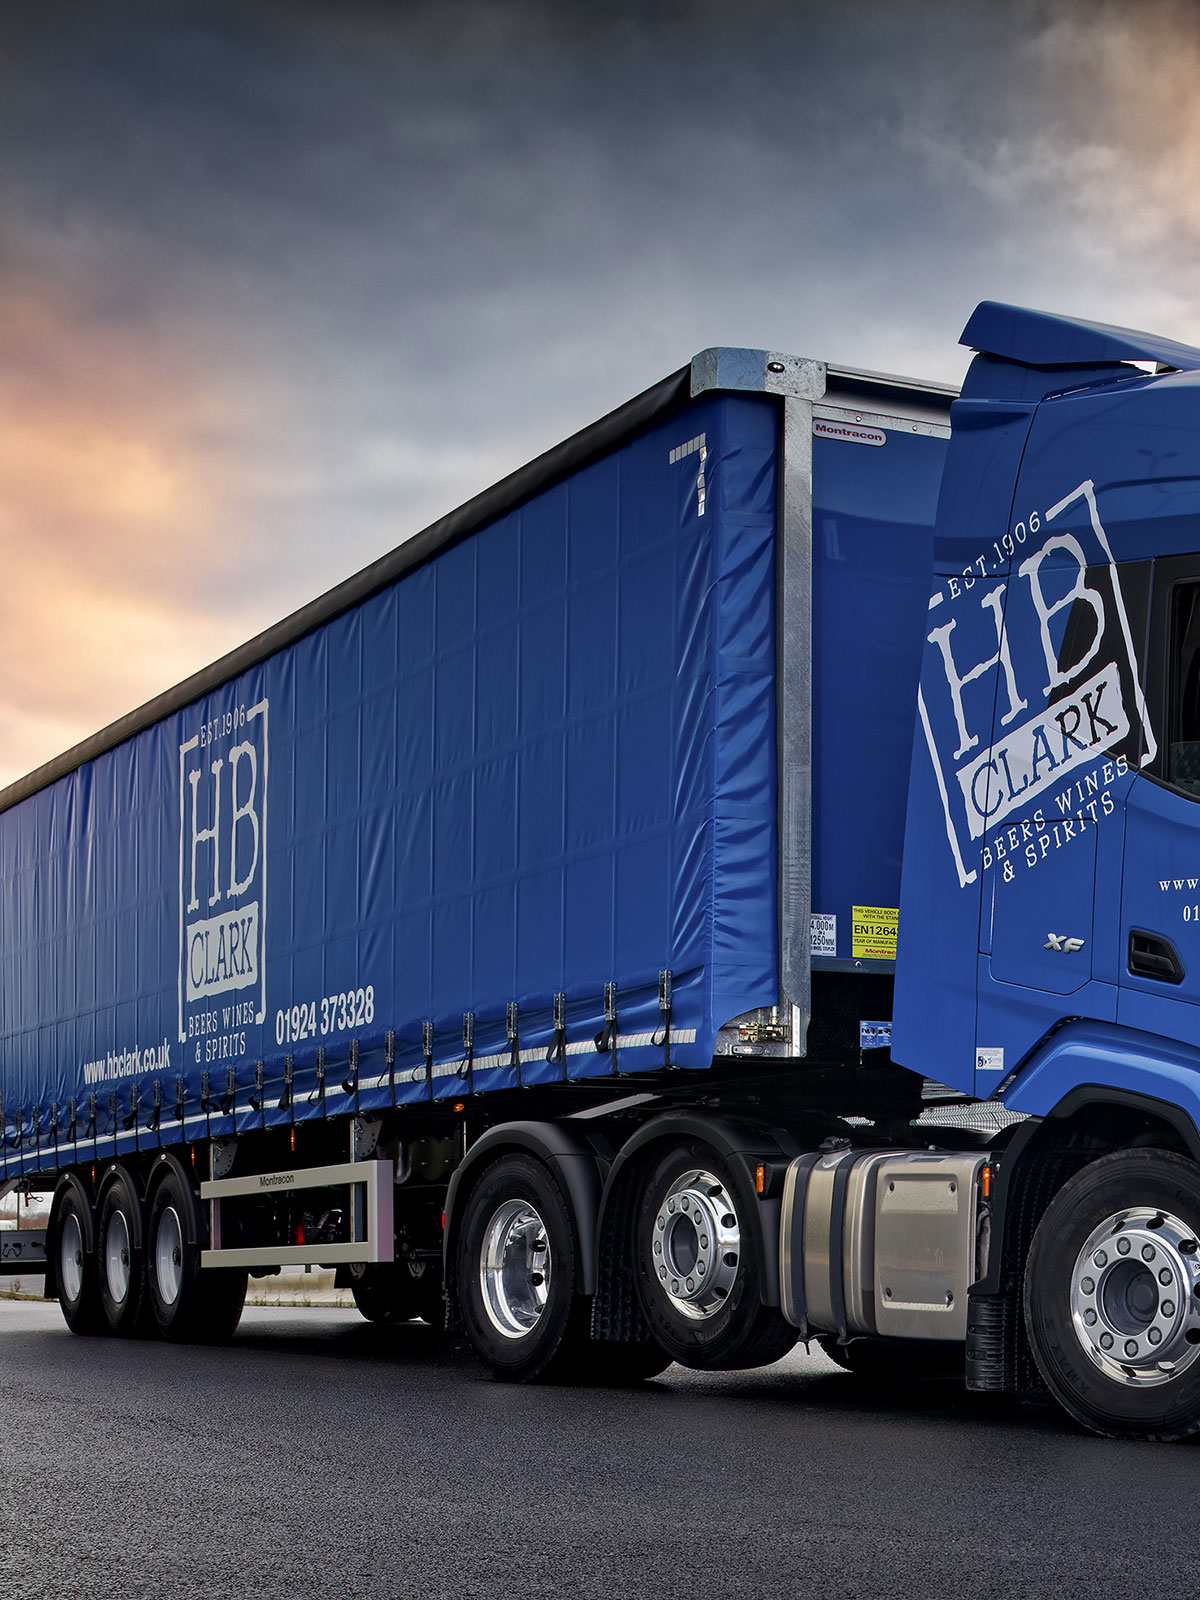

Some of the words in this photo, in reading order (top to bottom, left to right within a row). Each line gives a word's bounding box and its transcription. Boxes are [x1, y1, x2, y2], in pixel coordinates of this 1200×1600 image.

[815, 423, 882, 441] Montracon
[927, 533, 1105, 760] HB
[971, 681, 1118, 818] CLARK
[187, 740, 259, 913] HB
[980, 808, 1046, 870] BEERS
[1054, 754, 1128, 814] WINES
[1002, 859, 1015, 882] &
[1025, 791, 1114, 868] SPIRITS
[190, 917, 253, 988] CLARK
[854, 925, 898, 937] EN1264
[1043, 933, 1085, 954] XF
[188, 1010, 218, 1038] BEERS
[222, 1001, 254, 1028] WINES
[275, 1002, 317, 1045] 01924
[320, 985, 375, 1036] 373328
[84, 1037, 171, 1085] www.hbclark.co.uk
[195, 1045, 201, 1063] &
[205, 1032, 246, 1062] SPIRITS
[259, 1174, 295, 1187] Montracon
